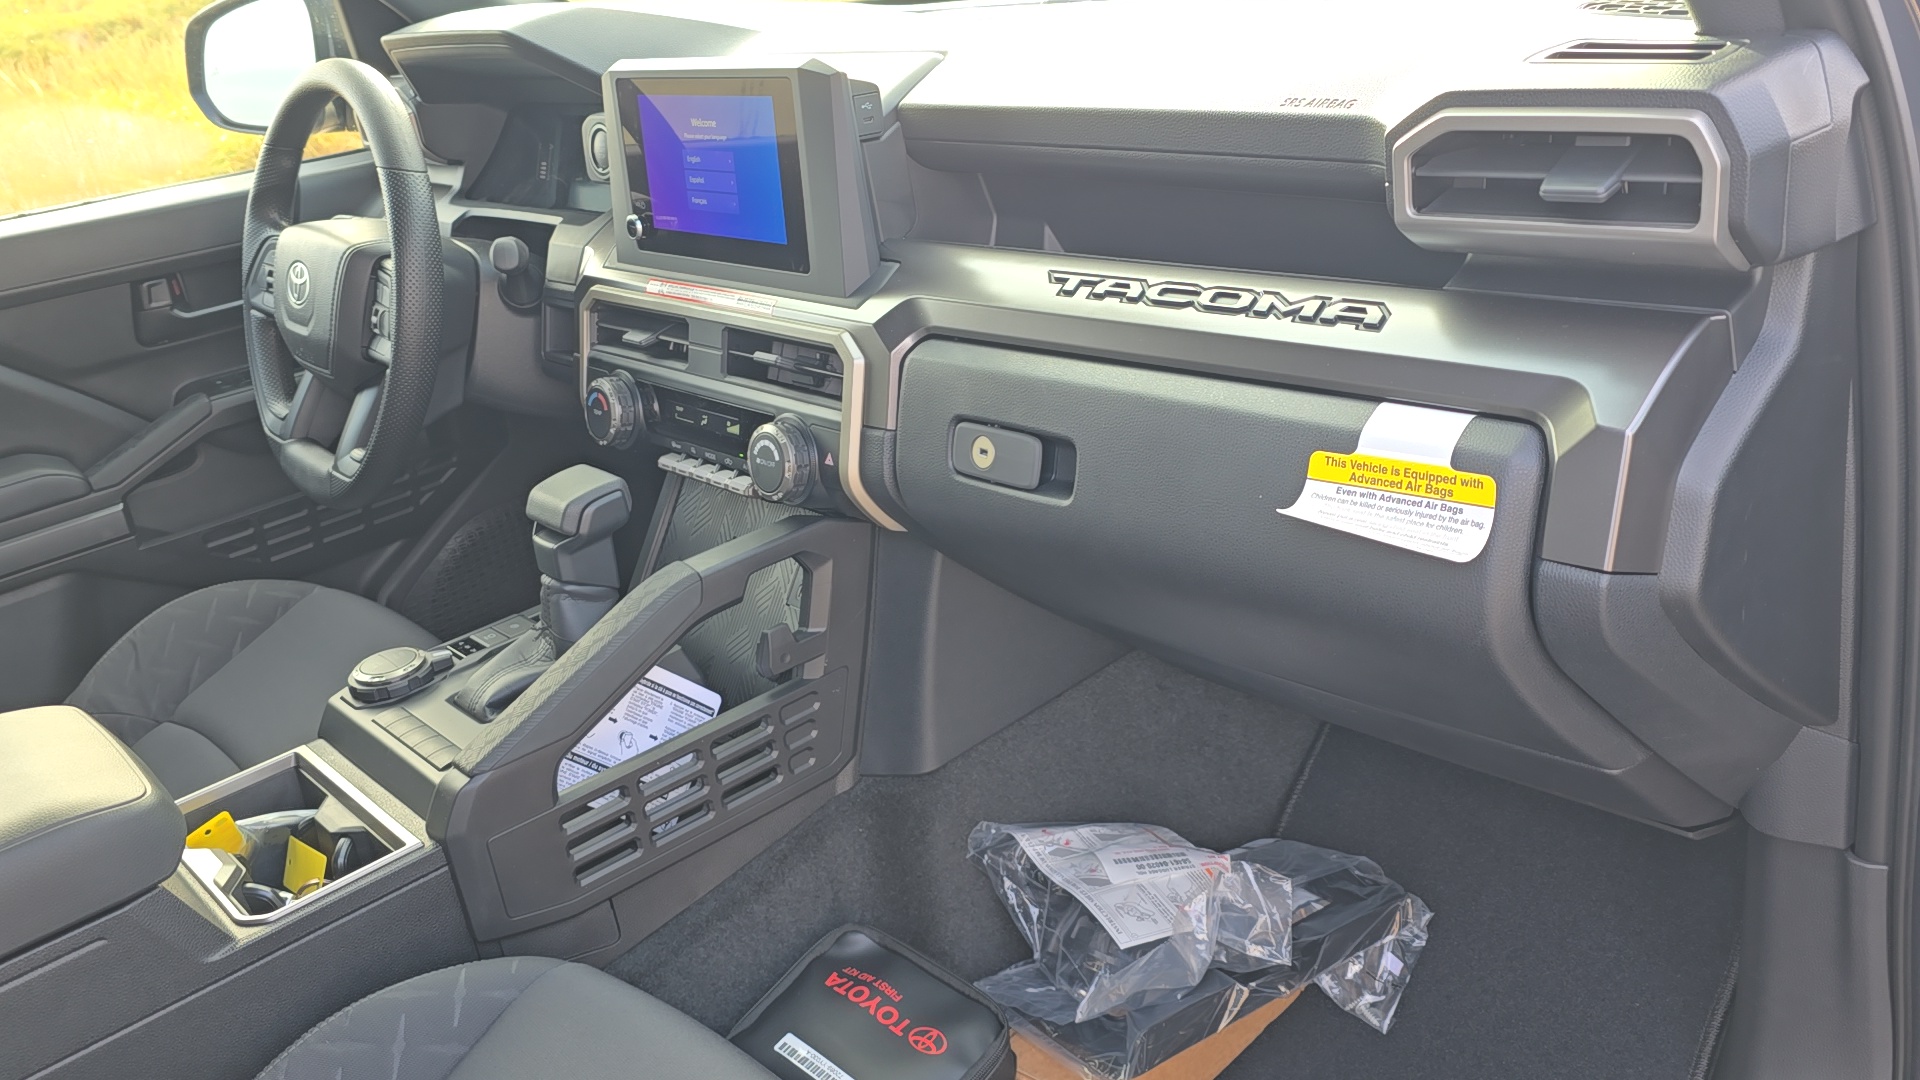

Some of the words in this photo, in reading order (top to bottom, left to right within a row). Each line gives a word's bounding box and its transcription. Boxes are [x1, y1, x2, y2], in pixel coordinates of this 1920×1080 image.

[1280, 97, 1306, 107] SRS
[1303, 97, 1358, 109] AIRBAG
[690, 117, 717, 128] Welcome
[1048, 269, 1392, 333] TACOMA
[1325, 455, 1347, 469] This
[1350, 459, 1388, 475] Vehicle
[1391, 465, 1401, 477] is
[1403, 467, 1457, 486] Equipped
[1460, 477, 1484, 490] with
[1349, 472, 1403, 490] Advanced
[1405, 480, 1422, 493] Air
[1425, 483, 1454, 499] Bags
[1311, 492, 1337, 503] Children
[1349, 499, 1358, 507] be
[1359, 501, 1376, 510] killed
[1385, 506, 1414, 518] seriously
[1414, 510, 1438, 521] injured
[1438, 514, 1447, 524] by
[1447, 516, 1459, 525] the
[1460, 518, 1470, 526] air
[1470, 519, 1486, 530] bag.
[1336, 486, 1358, 497] Even
[1359, 491, 1378, 501] with
[1379, 493, 1423, 508] Advanced
[1424, 500, 1438, 510] Air
[1440, 503, 1464, 516] Bags
[841, 966, 861, 977] KIT
[857, 972, 876, 983] AID
[824, 971, 911, 1037] TOYOTA
[872, 979, 904, 1003] FIRST
